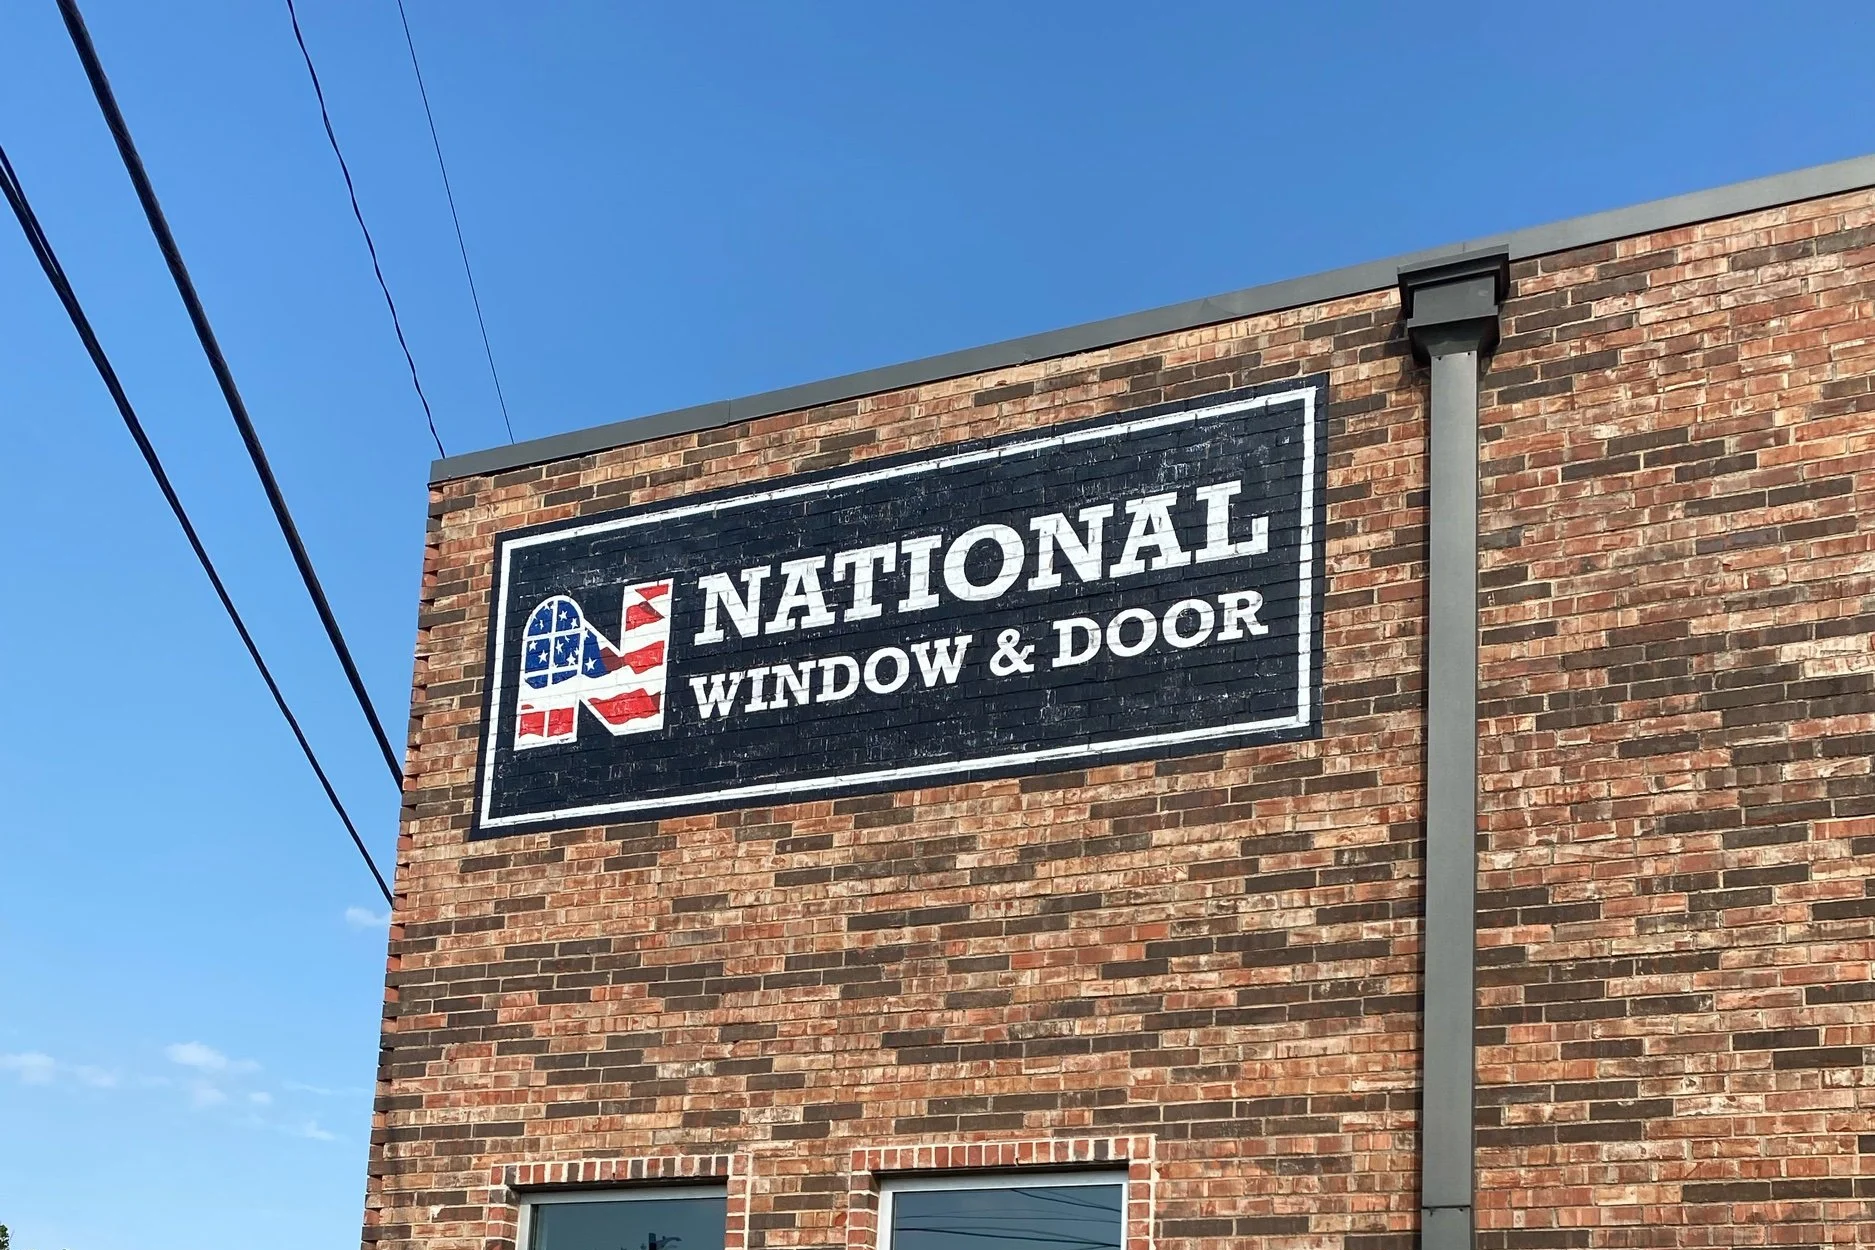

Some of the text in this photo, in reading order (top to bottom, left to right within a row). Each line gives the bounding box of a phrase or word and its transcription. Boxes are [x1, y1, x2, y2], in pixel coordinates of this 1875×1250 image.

[693, 480, 1268, 645] NATIONAL
[690, 590, 1268, 719] WINDOW & DOOR
